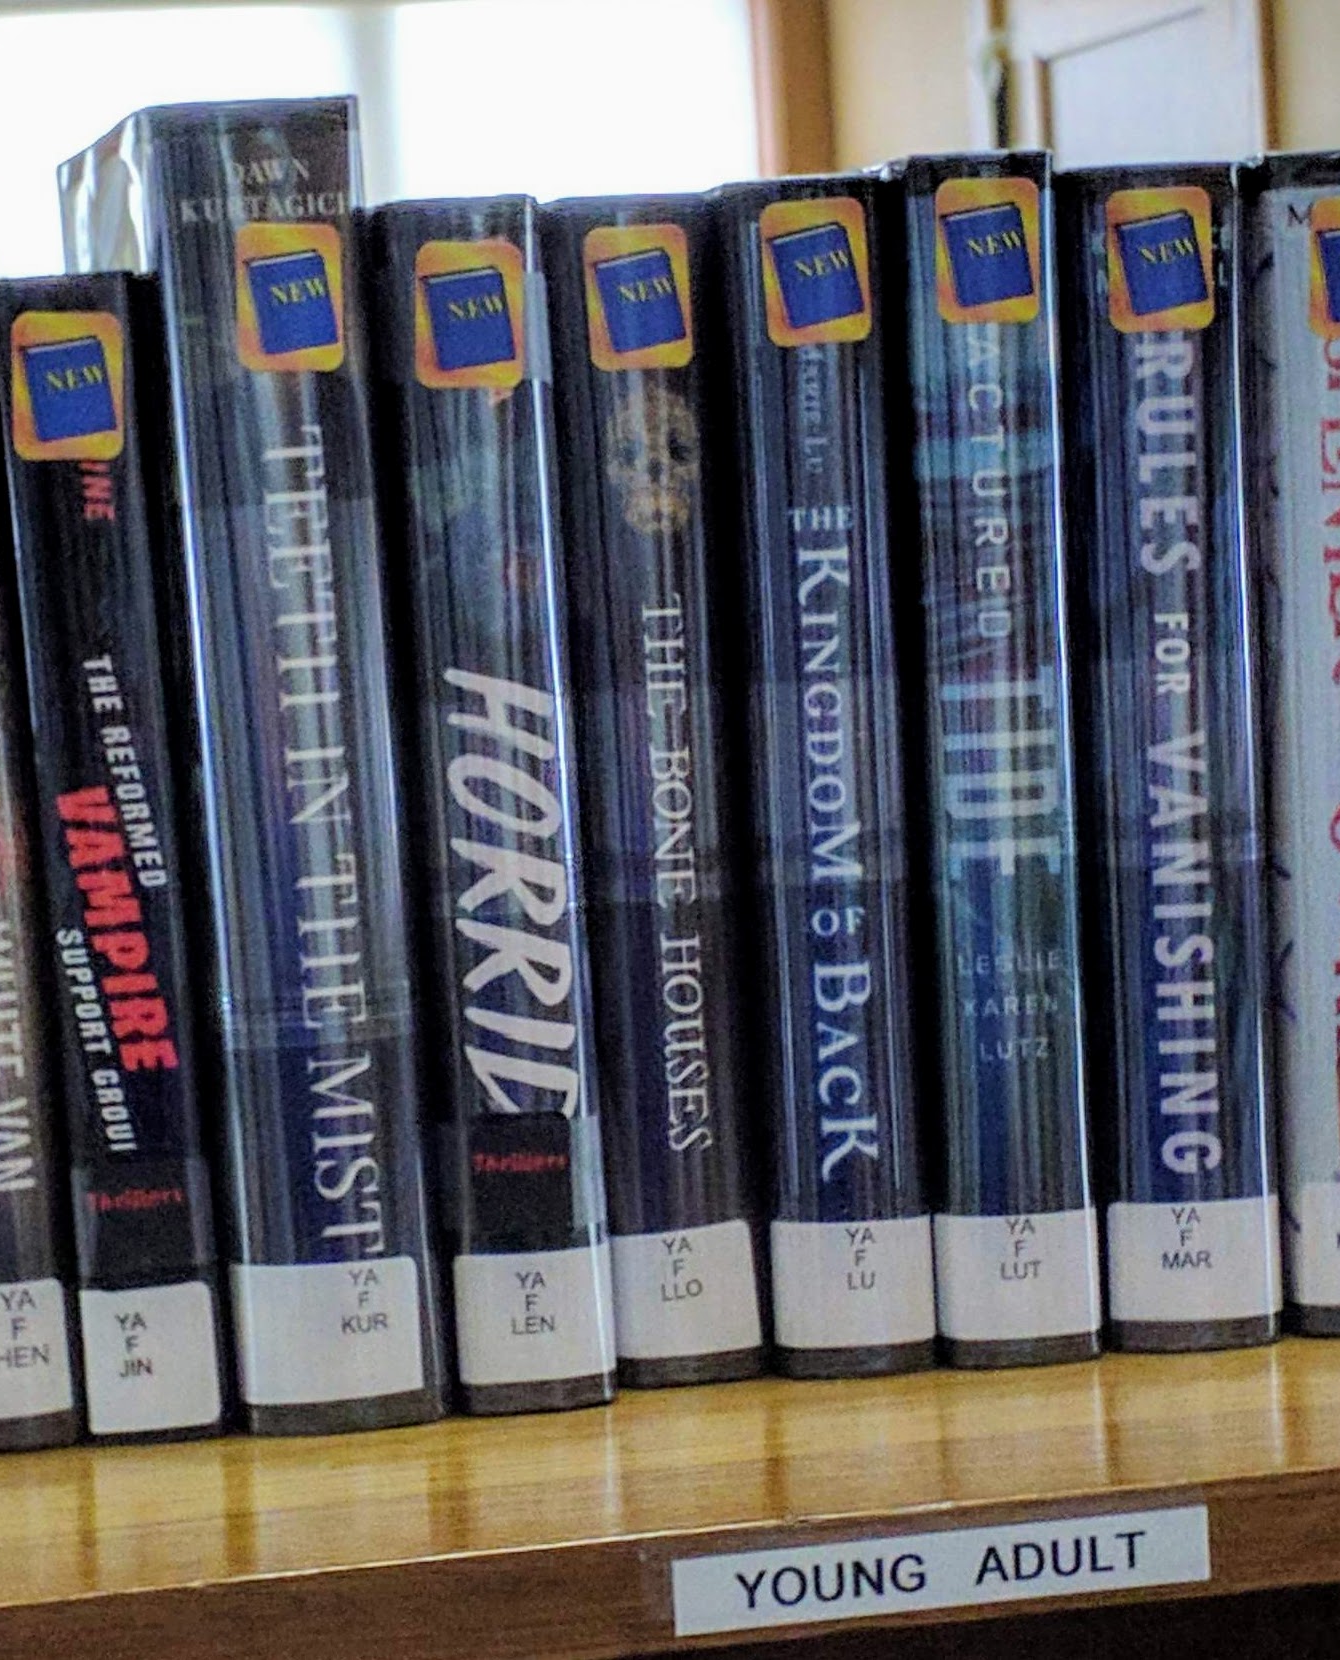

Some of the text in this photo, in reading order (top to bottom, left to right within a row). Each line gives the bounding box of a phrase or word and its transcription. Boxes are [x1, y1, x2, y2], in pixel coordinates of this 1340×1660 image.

[967, 230, 1023, 259] NEW
[1140, 237, 1196, 267] NEW
[794, 248, 851, 279] NEW
[270, 277, 327, 305] NEW
[618, 273, 675, 303] NEW
[448, 292, 507, 321] NEW
[44, 368, 104, 394] NEW
[965, 339, 1013, 639] ACTURED
[788, 505, 852, 531] THE
[1135, 332, 1221, 1175] RULES FOR VANISHING
[81, 654, 167, 888] THE REFORMED
[284, 741, 352, 827] IN
[641, 593, 712, 1154] THE BONE HOUSES
[797, 545, 879, 1183] KINGDOM OF BACK
[56, 786, 180, 1074] VAMPIRE
[297, 854, 367, 1029] THE
[959, 954, 1062, 975] LESLIE
[55, 929, 113, 1057] SUPPORT
[964, 994, 1059, 1016] KAREN
[981, 1039, 1050, 1060] LUTZ
[307, 1051, 382, 1259] MIST
[1005, 1219, 1035, 1236] YA
[1171, 1208, 1201, 1226] YA
[662, 1237, 692, 1256] YA
[846, 1227, 875, 1246] YA
[1013, 1239, 1027, 1256] F
[1180, 1230, 1194, 1246] F
[673, 1260, 685, 1278] F
[853, 1250, 867, 1267] F
[1161, 1249, 1212, 1270] MAR
[347, 1268, 379, 1287] YA
[516, 1272, 545, 1290] YA
[847, 1272, 875, 1290] LU
[1000, 1260, 1042, 1280] LUT
[0, 1290, 37, 1312] YA
[358, 1291, 371, 1308] F
[661, 1279, 703, 1301] LLO
[525, 1294, 539, 1312] F
[12, 1318, 27, 1340] F
[115, 1313, 147, 1332] YA
[340, 1313, 390, 1334] KUR
[511, 1315, 556, 1335] LEN
[125, 1336, 139, 1353] F
[119, 1358, 153, 1378] JIN
[736, 1531, 1147, 1609] YOUNG ADULT
